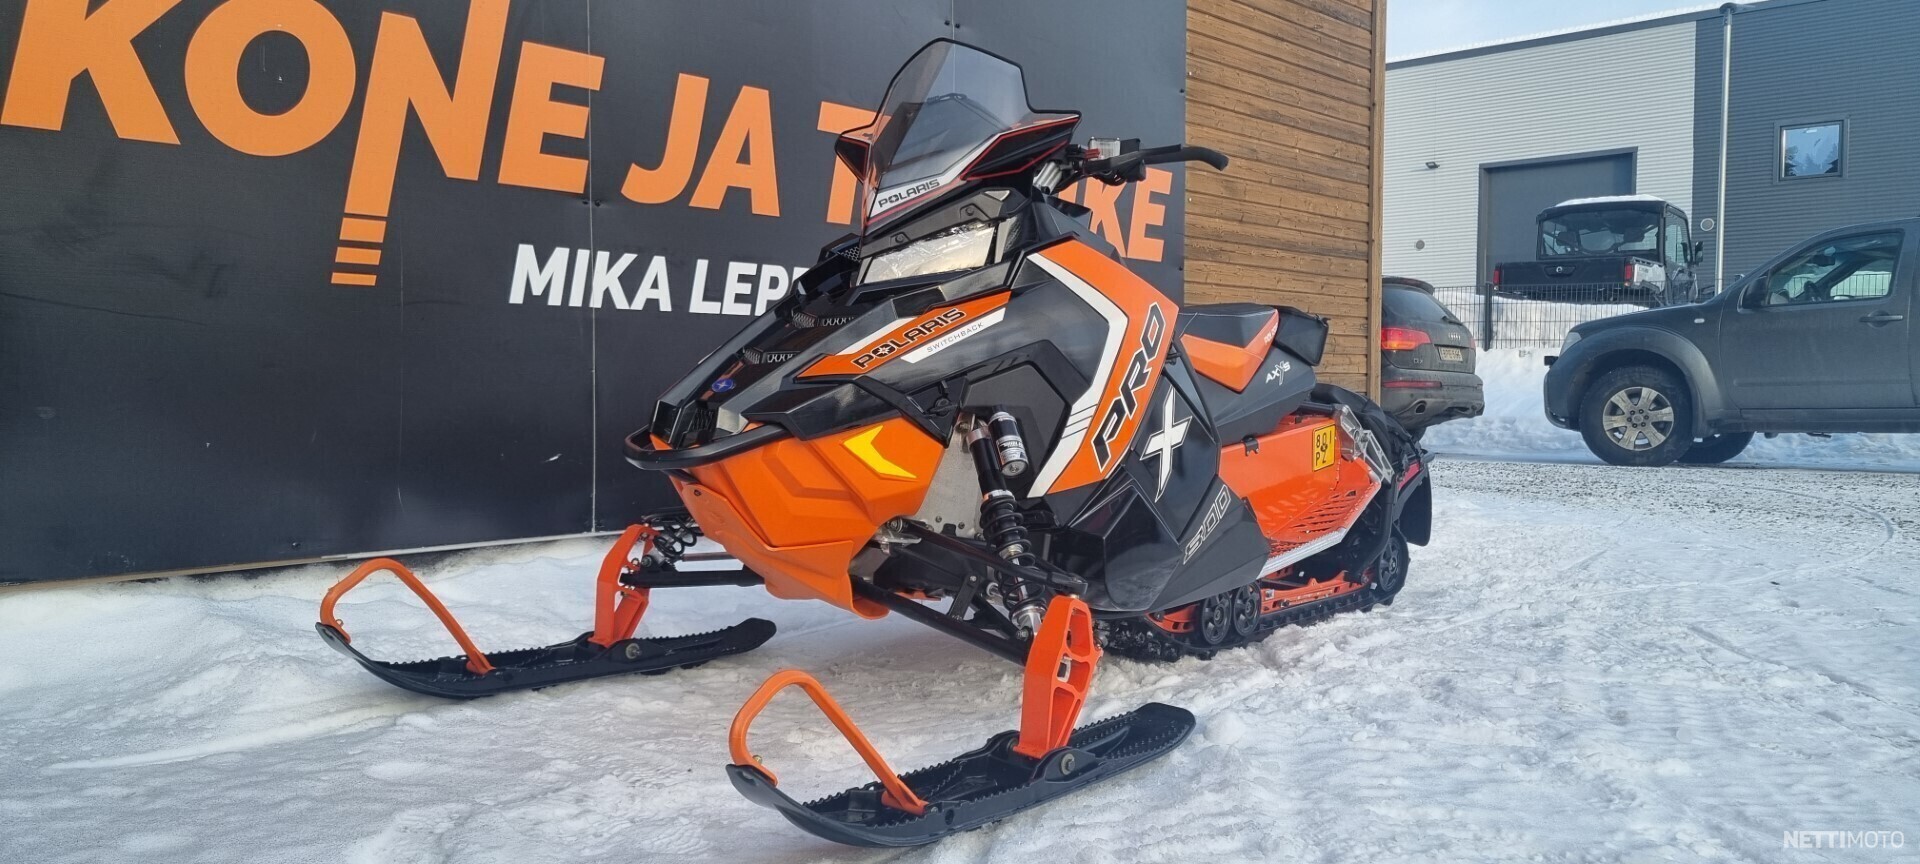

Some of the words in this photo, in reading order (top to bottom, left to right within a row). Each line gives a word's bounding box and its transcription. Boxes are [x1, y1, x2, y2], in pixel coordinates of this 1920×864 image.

[0, 0, 607, 286] KONE
[621, 72, 781, 217] JA
[878, 178, 941, 208] POLARIS
[508, 243, 672, 312] MIKA
[688, 258, 811, 317] LEP
[850, 307, 967, 371] POLARIS
[926, 321, 985, 353] SWITCHBACK
[1091, 301, 1167, 474] PRO
[1139, 383, 1193, 503] X
